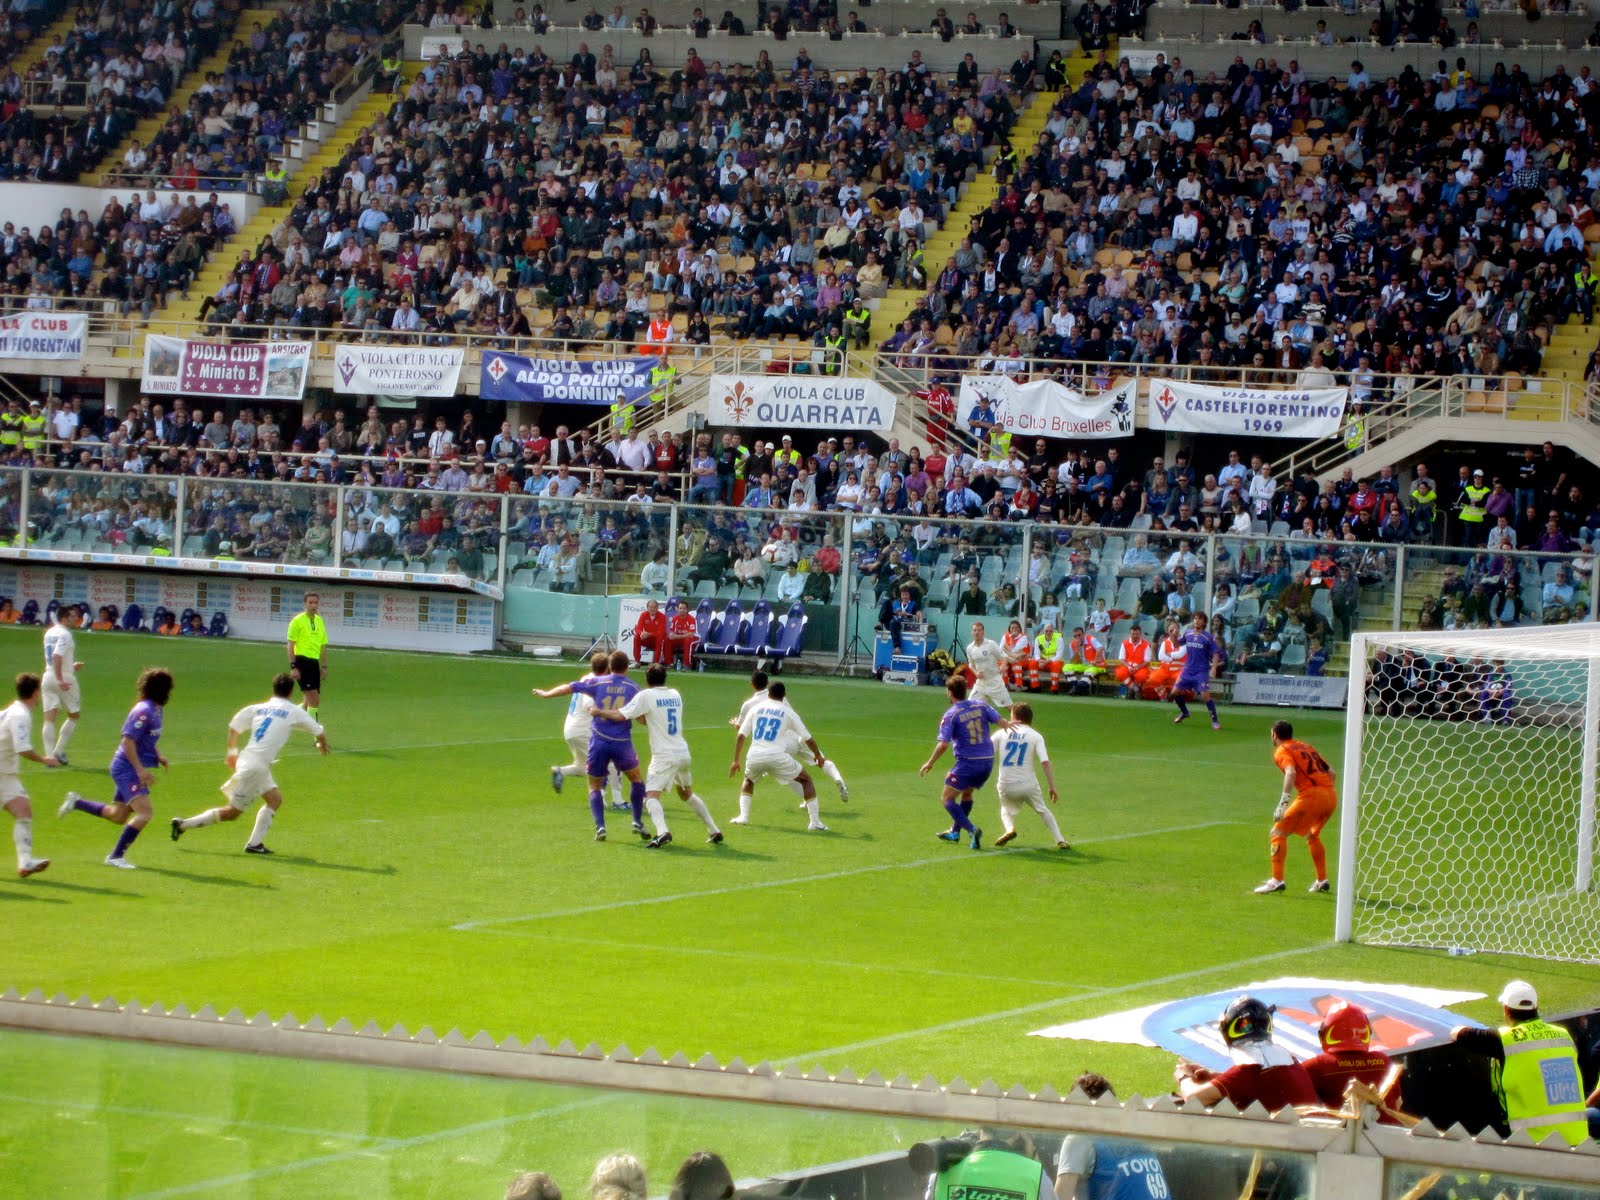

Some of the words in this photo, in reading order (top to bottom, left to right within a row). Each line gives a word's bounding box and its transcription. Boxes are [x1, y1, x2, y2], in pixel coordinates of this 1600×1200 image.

[31, 318, 68, 331] CLUB
[12, 337, 81, 352] FIORENTINI
[191, 344, 227, 361] VIOLA
[230, 347, 260, 362] CLUB
[271, 345, 307, 355] ARSIERO
[361, 352, 394, 365] VIOLA
[396, 353, 426, 366] CLUB
[529, 358, 582, 374] VIOLA
[592, 361, 636, 374] CLUB
[186, 363, 196, 378] S.
[199, 363, 245, 380] Miniato
[249, 367, 260, 381] B.
[368, 368, 443, 380] PONTEROSSO
[515, 370, 563, 385] ALDO
[568, 374, 649, 388] POLIDOR
[153, 381, 177, 391] MINIATO
[773, 386, 818, 400] VIOLA
[823, 387, 865, 401] CLUB
[1222, 391, 1266, 399] VIOLA
[1273, 393, 1311, 401] CLUB
[757, 403, 882, 426] QUARRATA
[1185, 399, 1341, 418] CASTELFIORENTINO
[1018, 414, 1047, 430] Club
[1051, 415, 1112, 433] Bruxelles
[1244, 419, 1283, 432] 1969
[254, 717, 273, 742] 4
[667, 708, 677, 736] 5
[754, 716, 782, 742] 83
[966, 717, 984, 745] 11
[1003, 741, 1028, 767] 21
[1117, 1158, 1163, 1177] TOYO
[1146, 1173, 1167, 1199] 69
